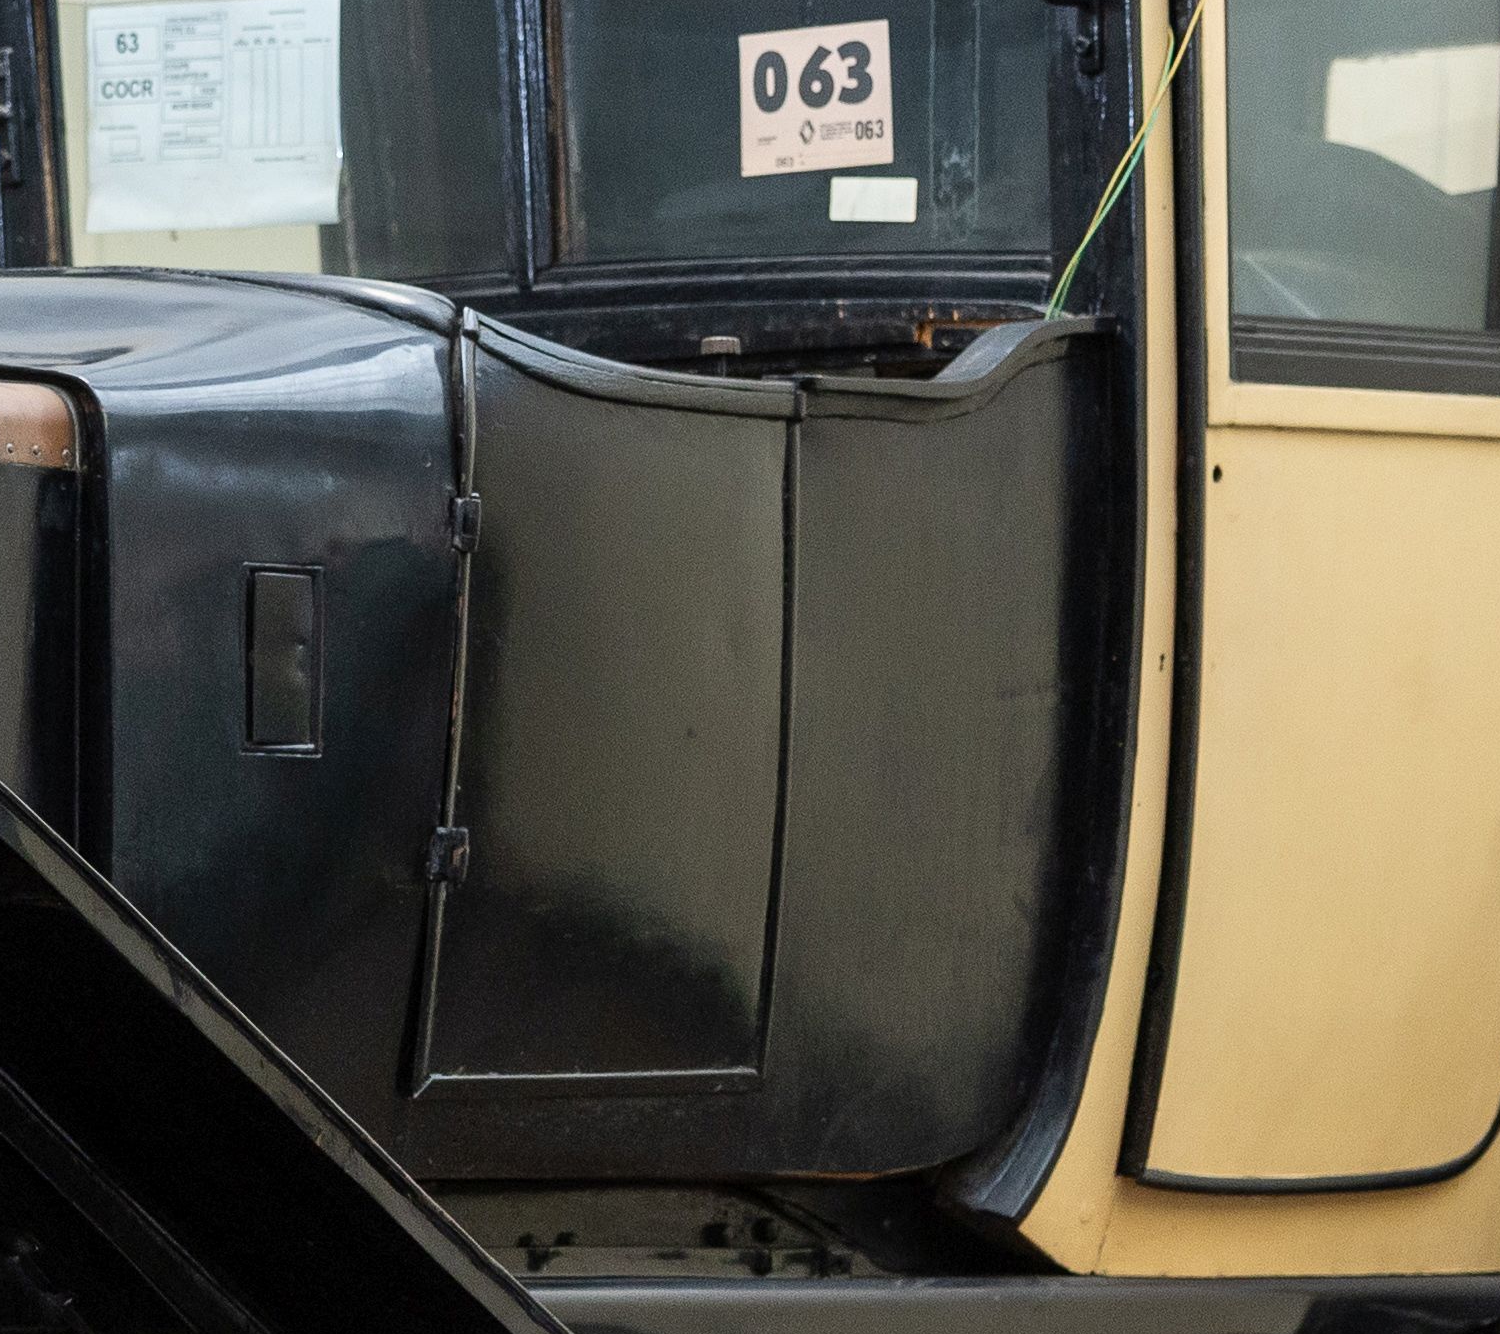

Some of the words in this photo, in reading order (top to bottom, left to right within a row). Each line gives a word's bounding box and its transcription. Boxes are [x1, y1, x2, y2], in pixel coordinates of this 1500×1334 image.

[115, 32, 139, 55] 63
[753, 40, 874, 113] 063
[101, 79, 154, 100] COCR
[855, 119, 885, 141] 063
